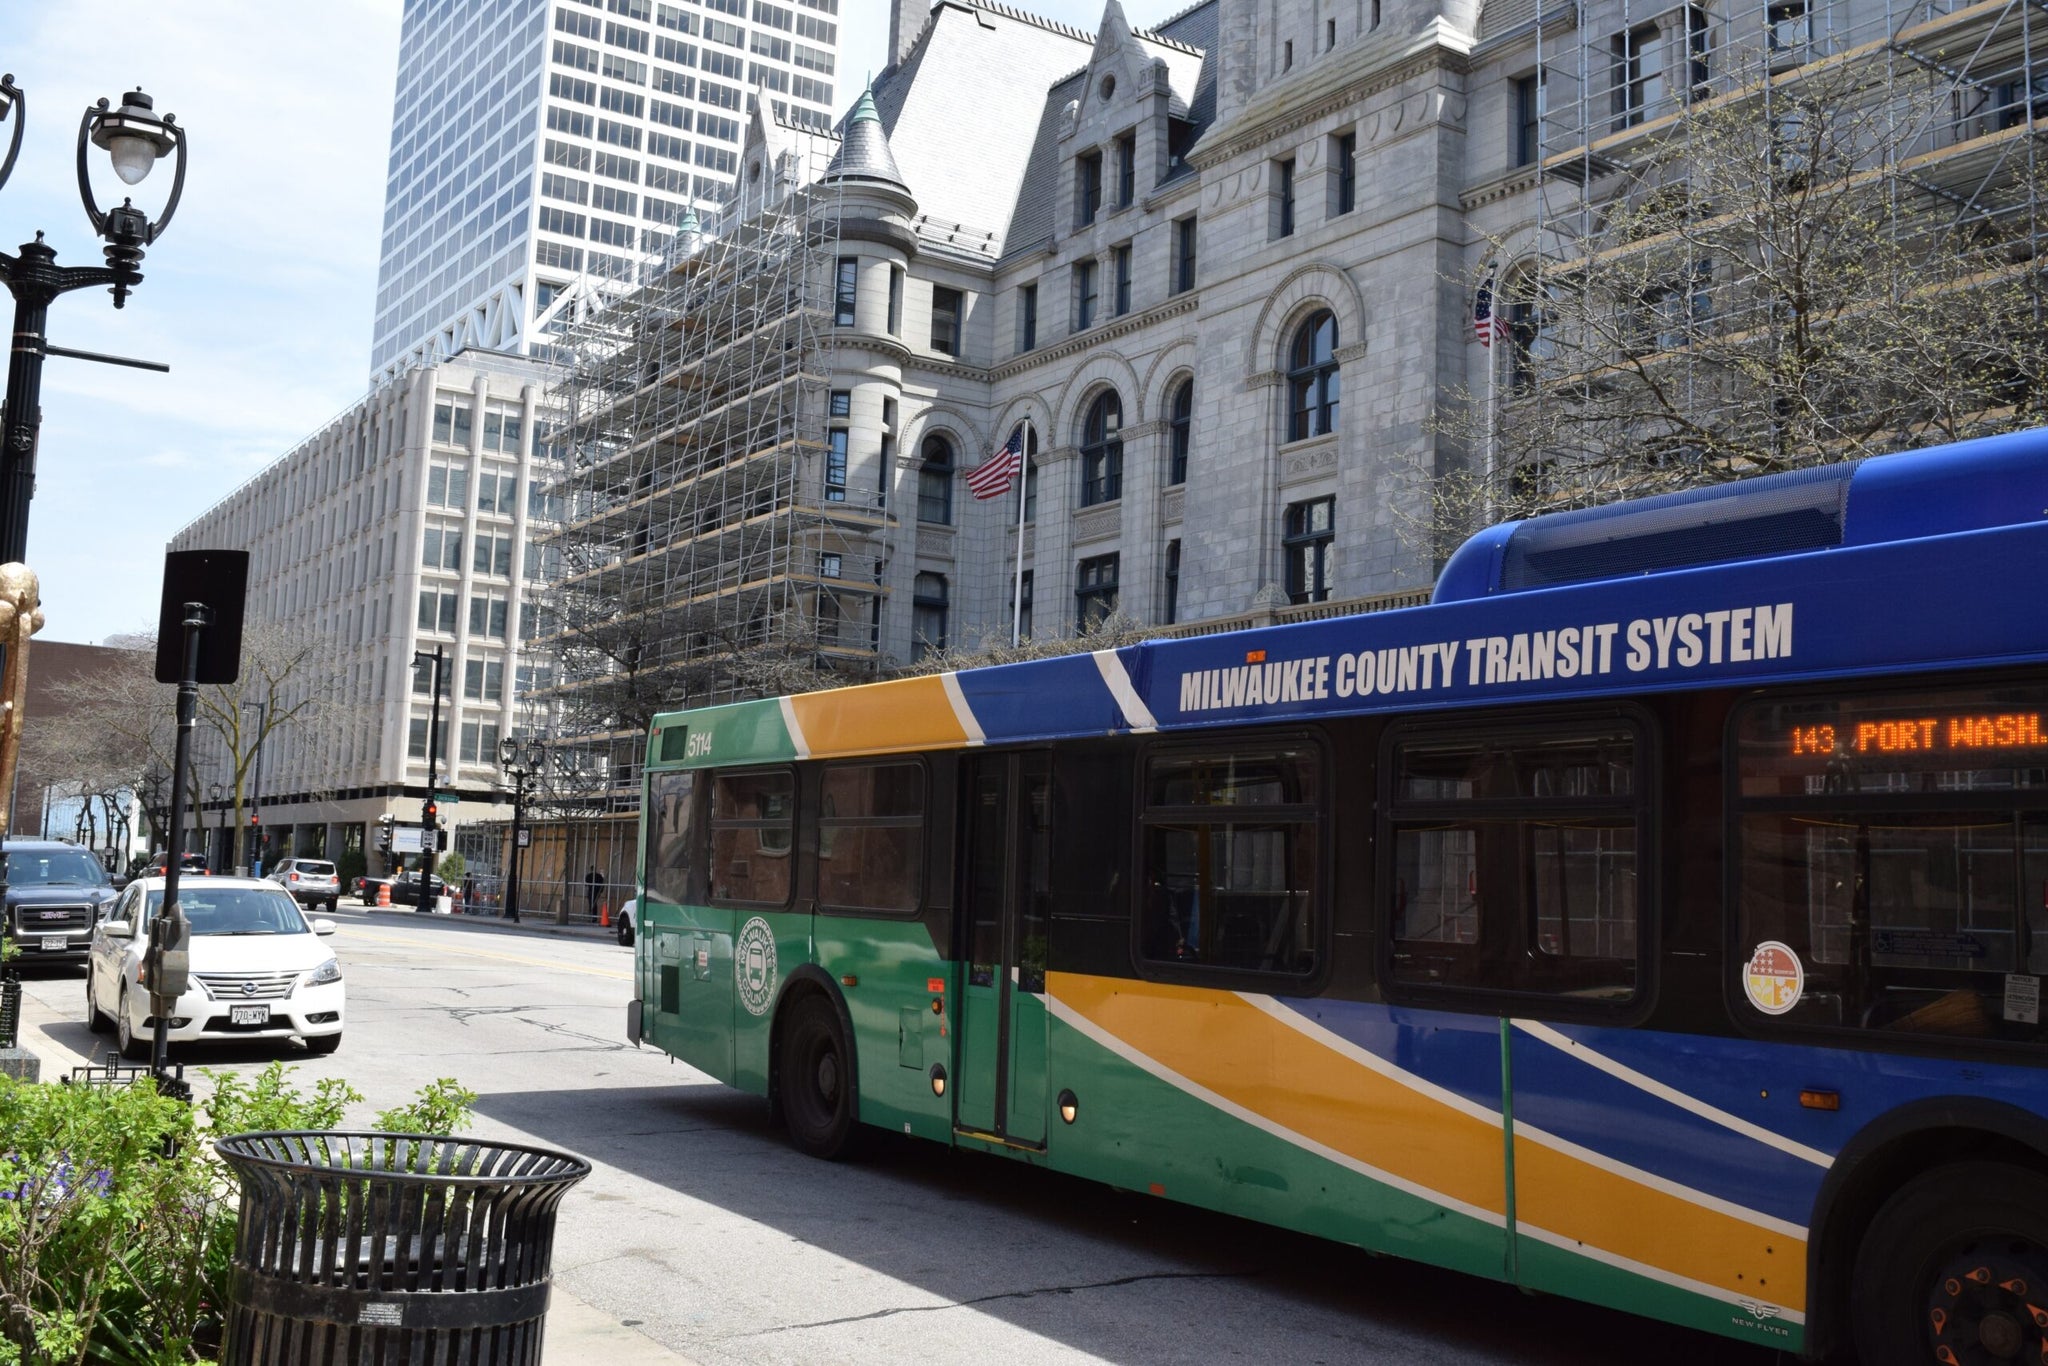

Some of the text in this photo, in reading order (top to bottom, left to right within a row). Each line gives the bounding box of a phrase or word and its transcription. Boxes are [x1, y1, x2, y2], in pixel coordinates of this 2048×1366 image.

[1180, 602, 1794, 712] MILWAUKEE COUNTY TRANSIT SYSTEM
[688, 731, 712, 757] 5114
[1793, 713, 2048, 753] 143 PORT WASH.
[740, 928, 773, 969] MILWAUKEE
[741, 978, 769, 1005] COUNTY
[1732, 1317, 1789, 1336] NEW FLYER
